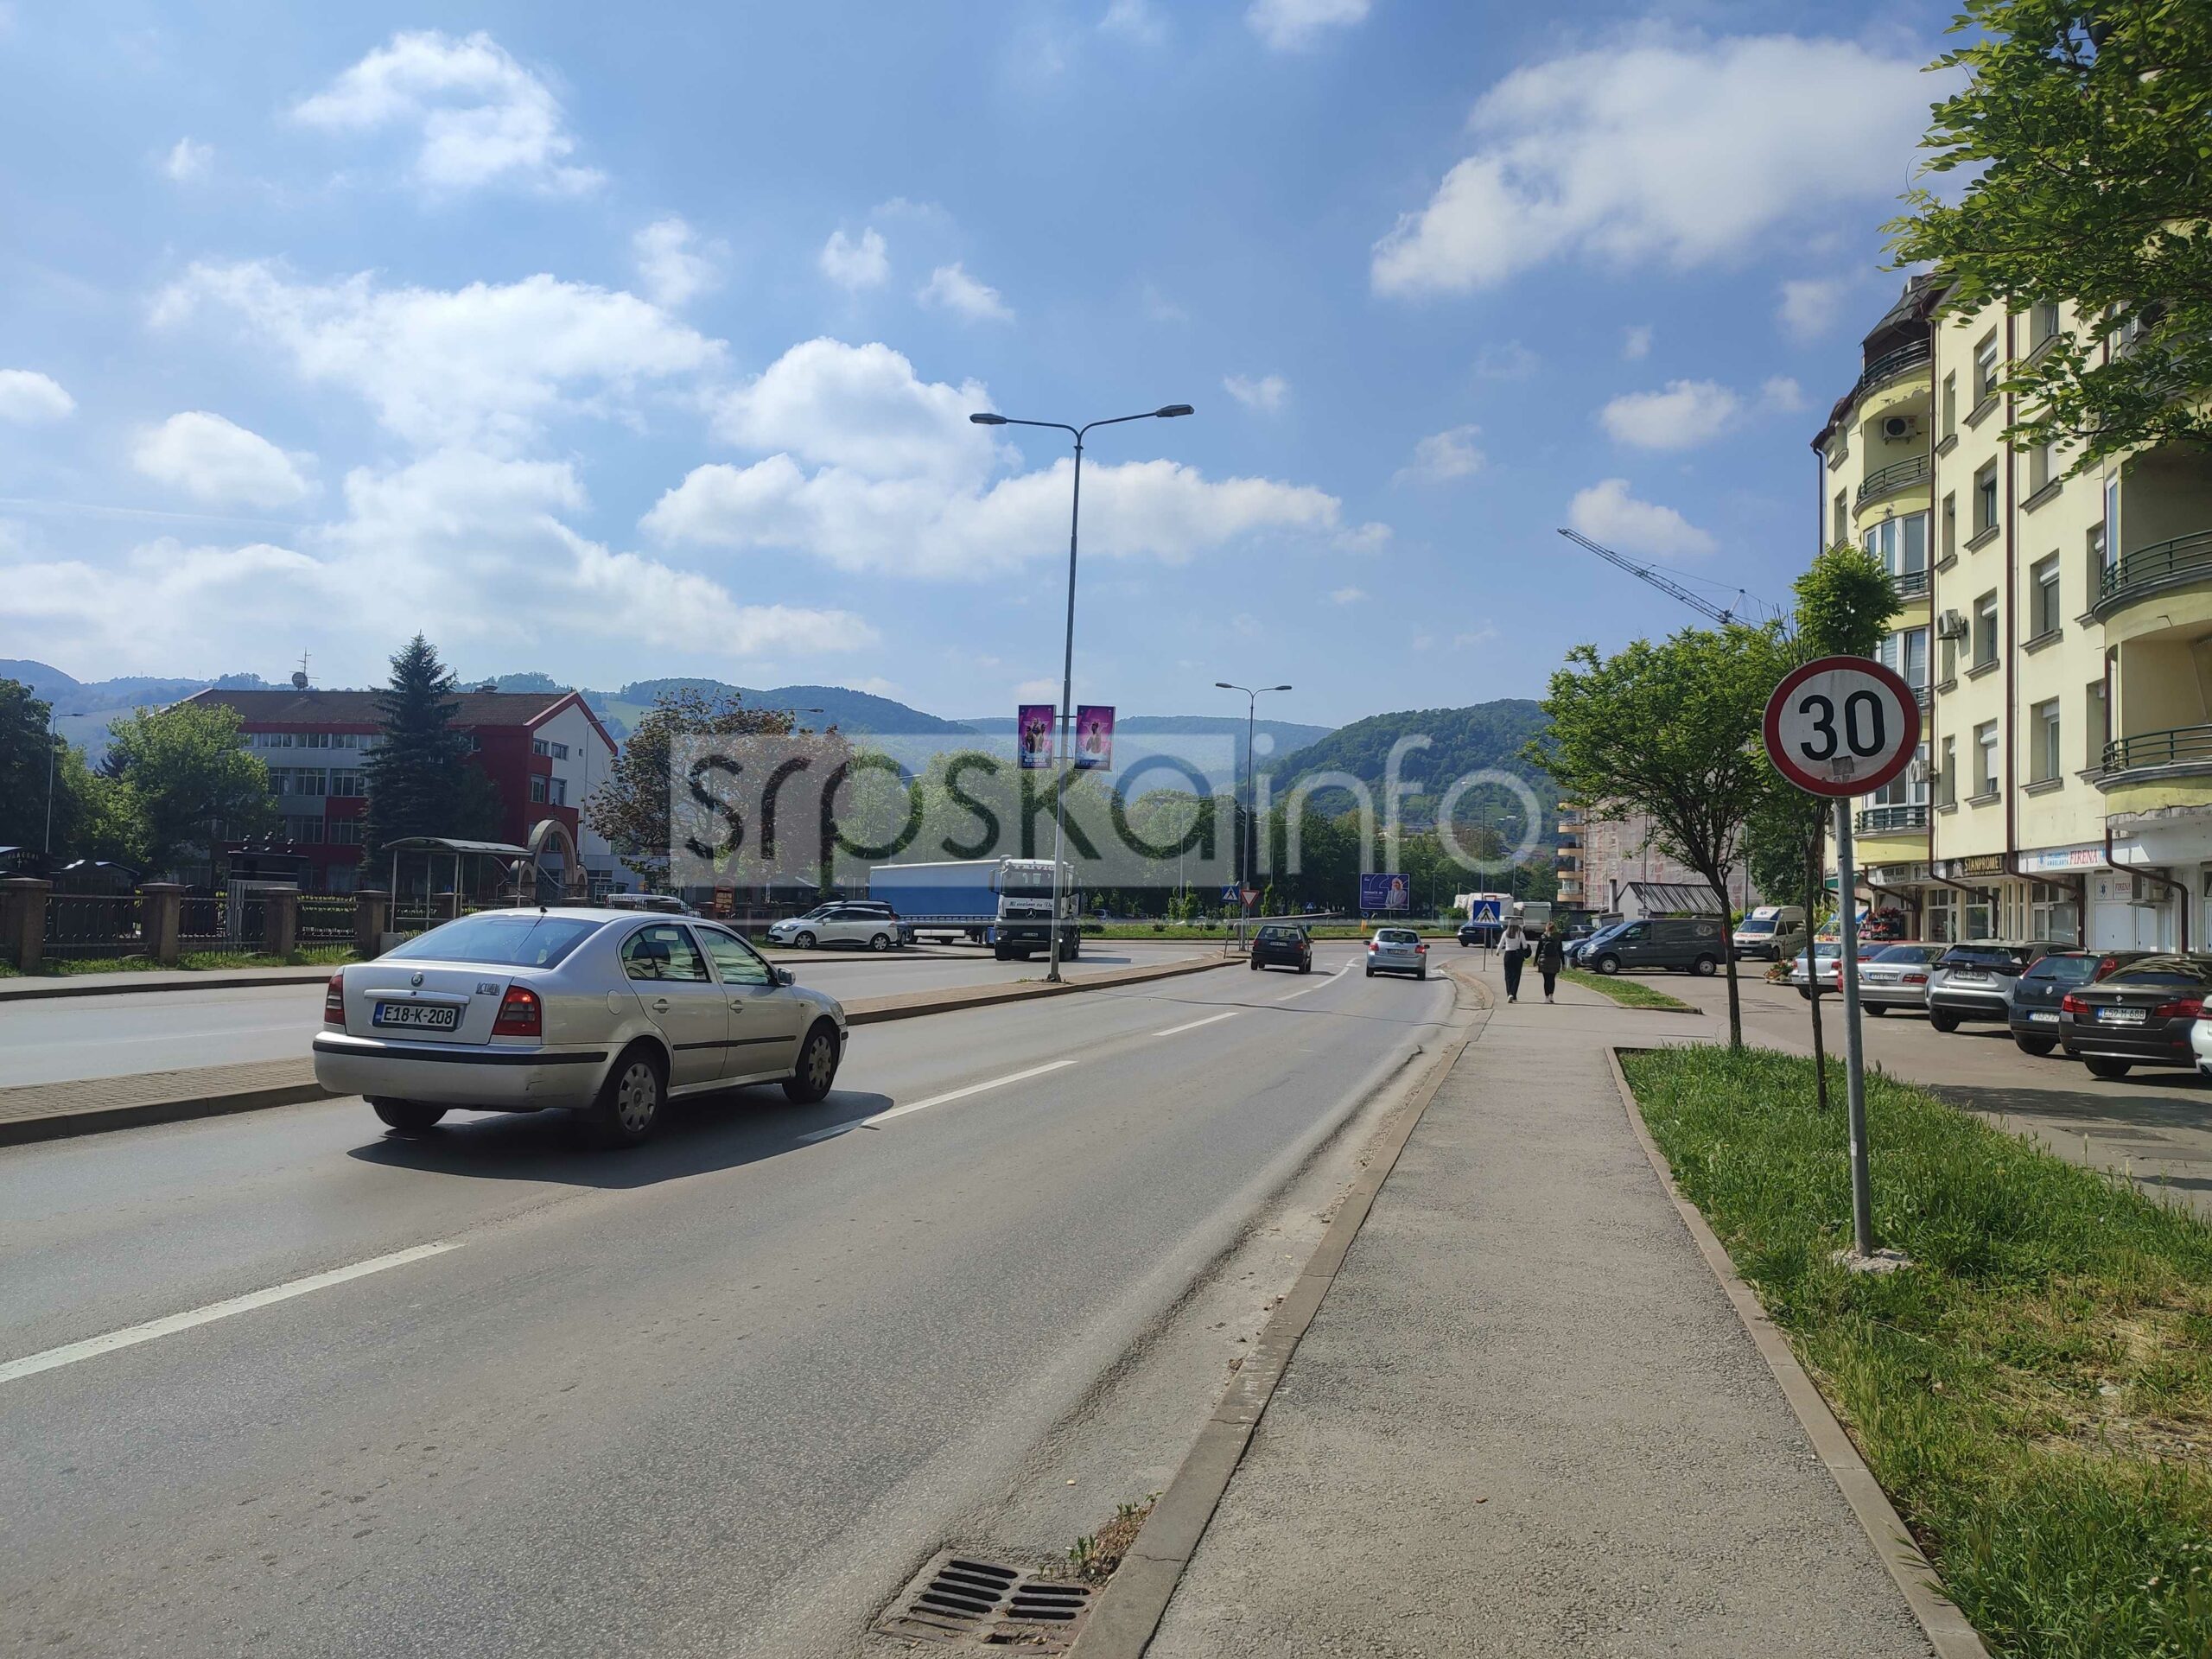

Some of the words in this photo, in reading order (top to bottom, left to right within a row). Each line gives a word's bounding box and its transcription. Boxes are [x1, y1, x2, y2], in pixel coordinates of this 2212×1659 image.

[1799, 690, 1885, 761] 30
[1964, 855, 2003, 873] STANPROMET
[2069, 849, 2098, 865] FIRENA
[2115, 882, 2131, 891] FIRENA
[384, 1005, 454, 1025] E18-K-208
